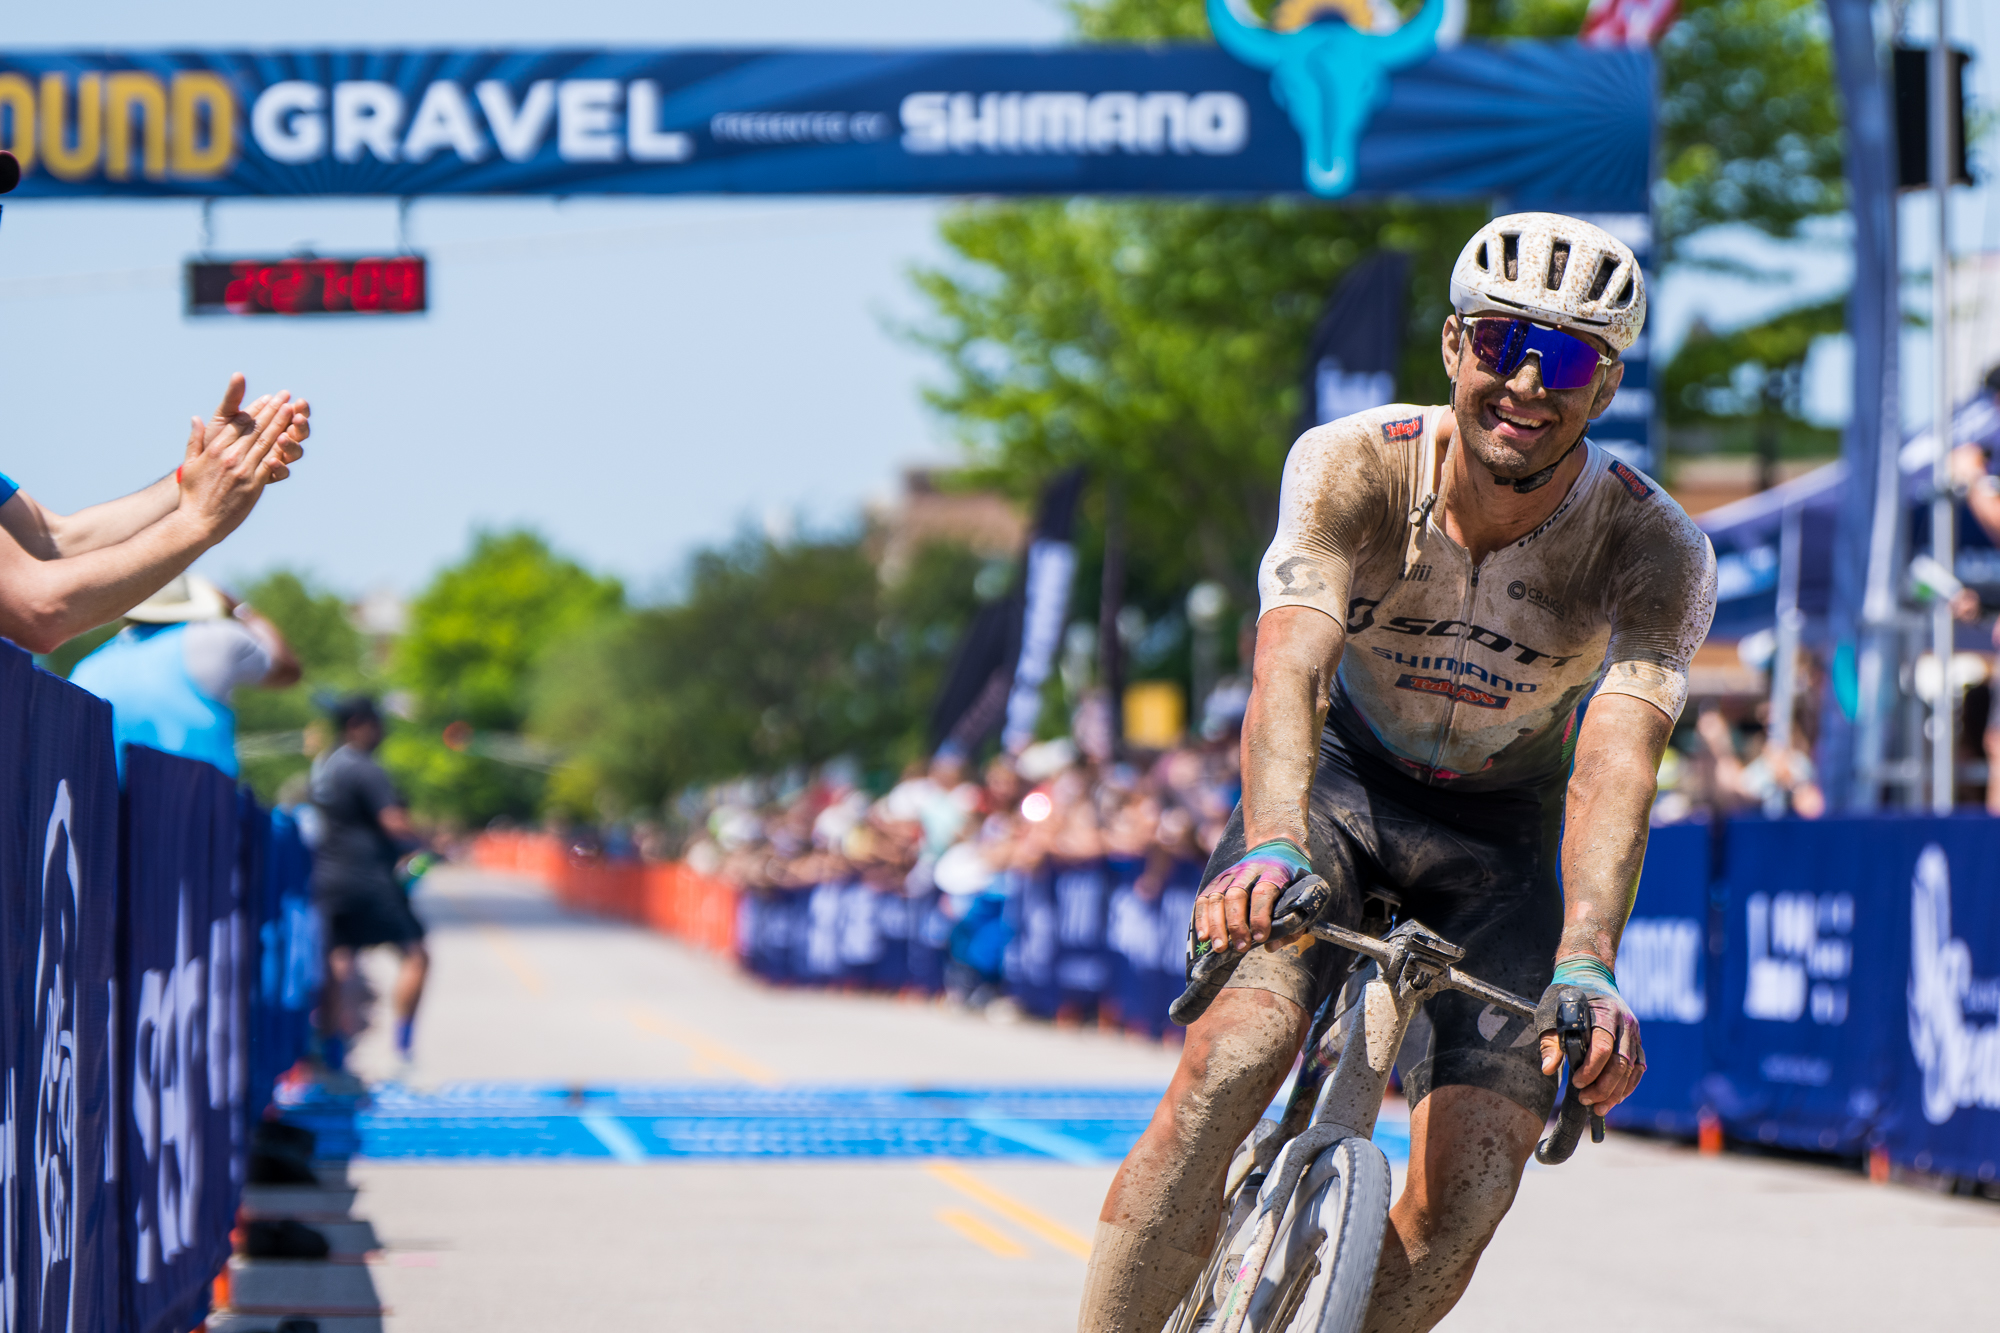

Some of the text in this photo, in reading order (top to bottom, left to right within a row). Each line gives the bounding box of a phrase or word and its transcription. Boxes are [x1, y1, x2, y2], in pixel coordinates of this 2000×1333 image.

[252, 79, 690, 163] GRAVEL
[900, 91, 1248, 155] SHIMANO
[1385, 418, 1420, 438] Talley's
[1616, 462, 1648, 496] Talley's
[1527, 587, 1566, 617] CRAIGS
[1378, 616, 1583, 668] SCOTT
[1371, 646, 1538, 693] SHIMANO
